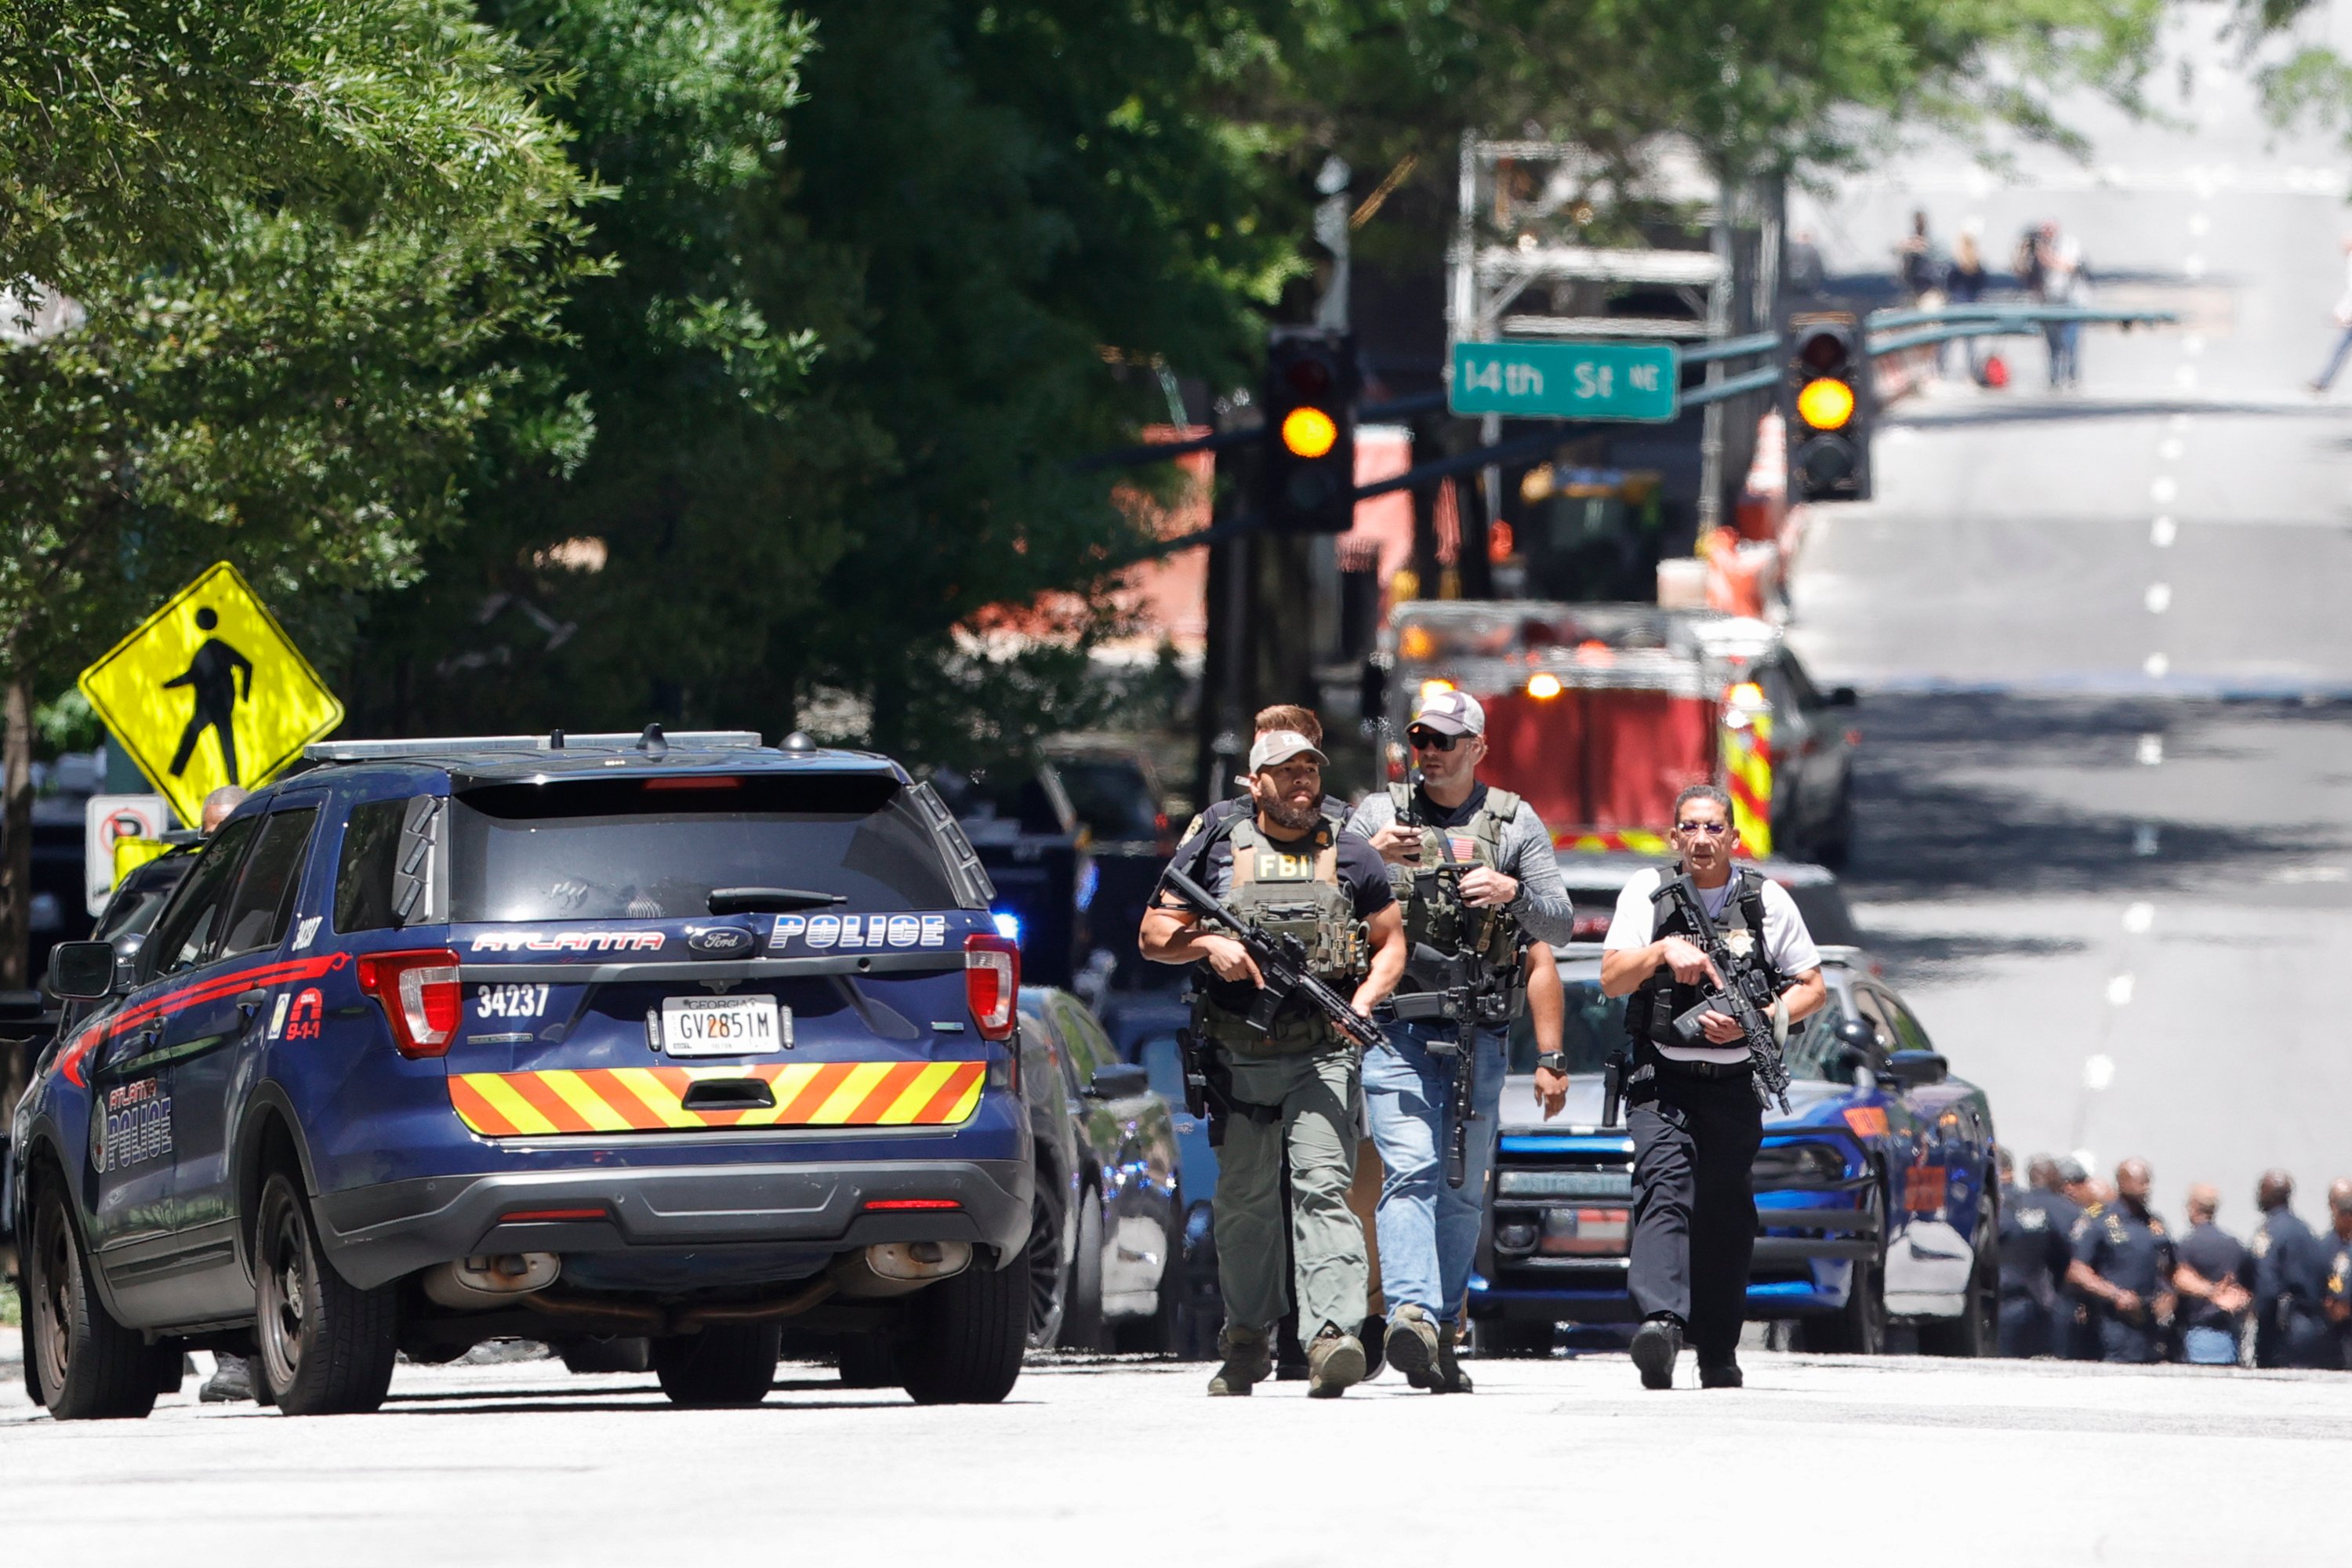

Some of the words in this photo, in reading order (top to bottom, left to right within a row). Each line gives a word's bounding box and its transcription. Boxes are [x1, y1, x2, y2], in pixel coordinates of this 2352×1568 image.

[1465, 360, 1544, 396] 14th
[1573, 361, 1613, 398] St
[1629, 363, 1661, 392] NE
[1260, 855, 1308, 877] FBI
[470, 931, 666, 952] ATLANTA
[704, 932, 739, 948] Ford
[768, 914, 946, 949] POLICE
[300, 993, 317, 1004] DIAL
[477, 983, 550, 1018] 34237
[688, 999, 748, 1011] GEORGIA
[286, 1021, 321, 1040] 9-1-1
[681, 1011, 770, 1039] GV2851M
[109, 1077, 157, 1112] ATLANTA
[108, 1097, 172, 1171] POLICE
